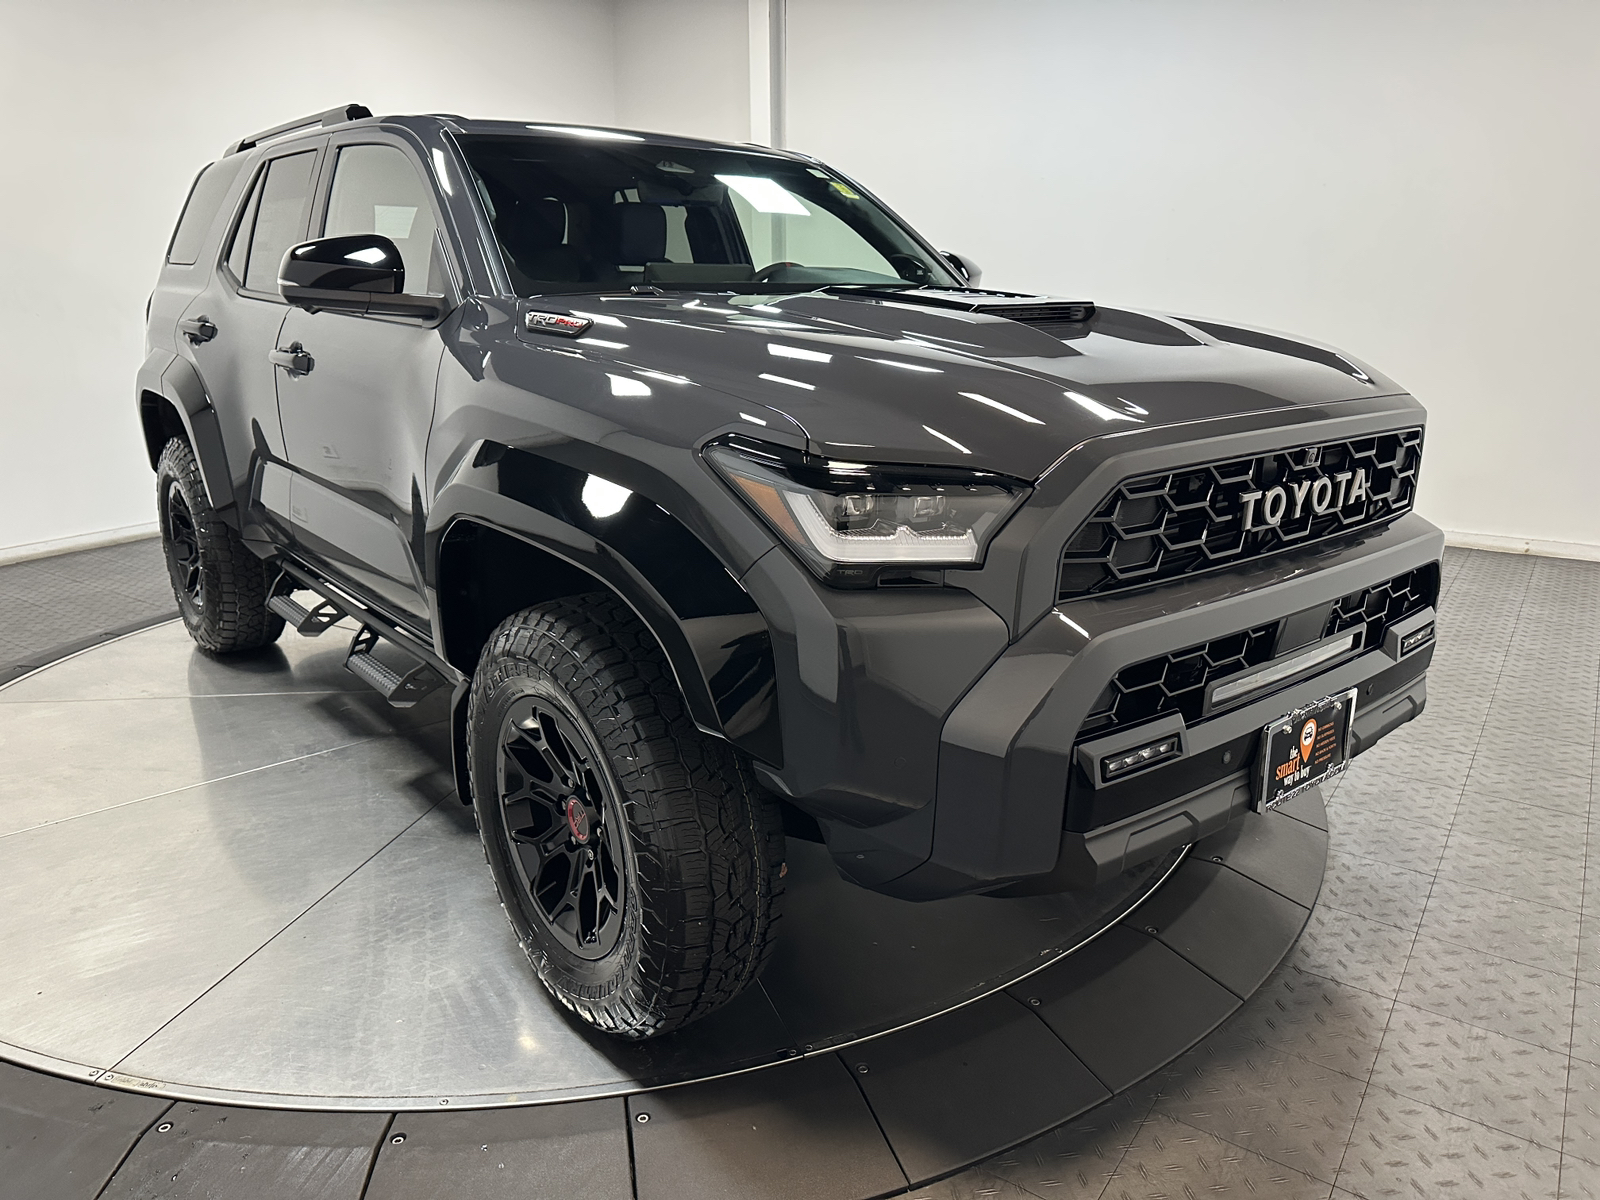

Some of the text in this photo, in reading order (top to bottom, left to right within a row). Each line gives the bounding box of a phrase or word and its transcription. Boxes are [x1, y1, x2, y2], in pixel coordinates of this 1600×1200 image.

[1239, 467, 1366, 532] TOYOTA
[1289, 745, 1300, 760] the
[1275, 753, 1301, 781] smart
[1300, 764, 1312, 779] buy
